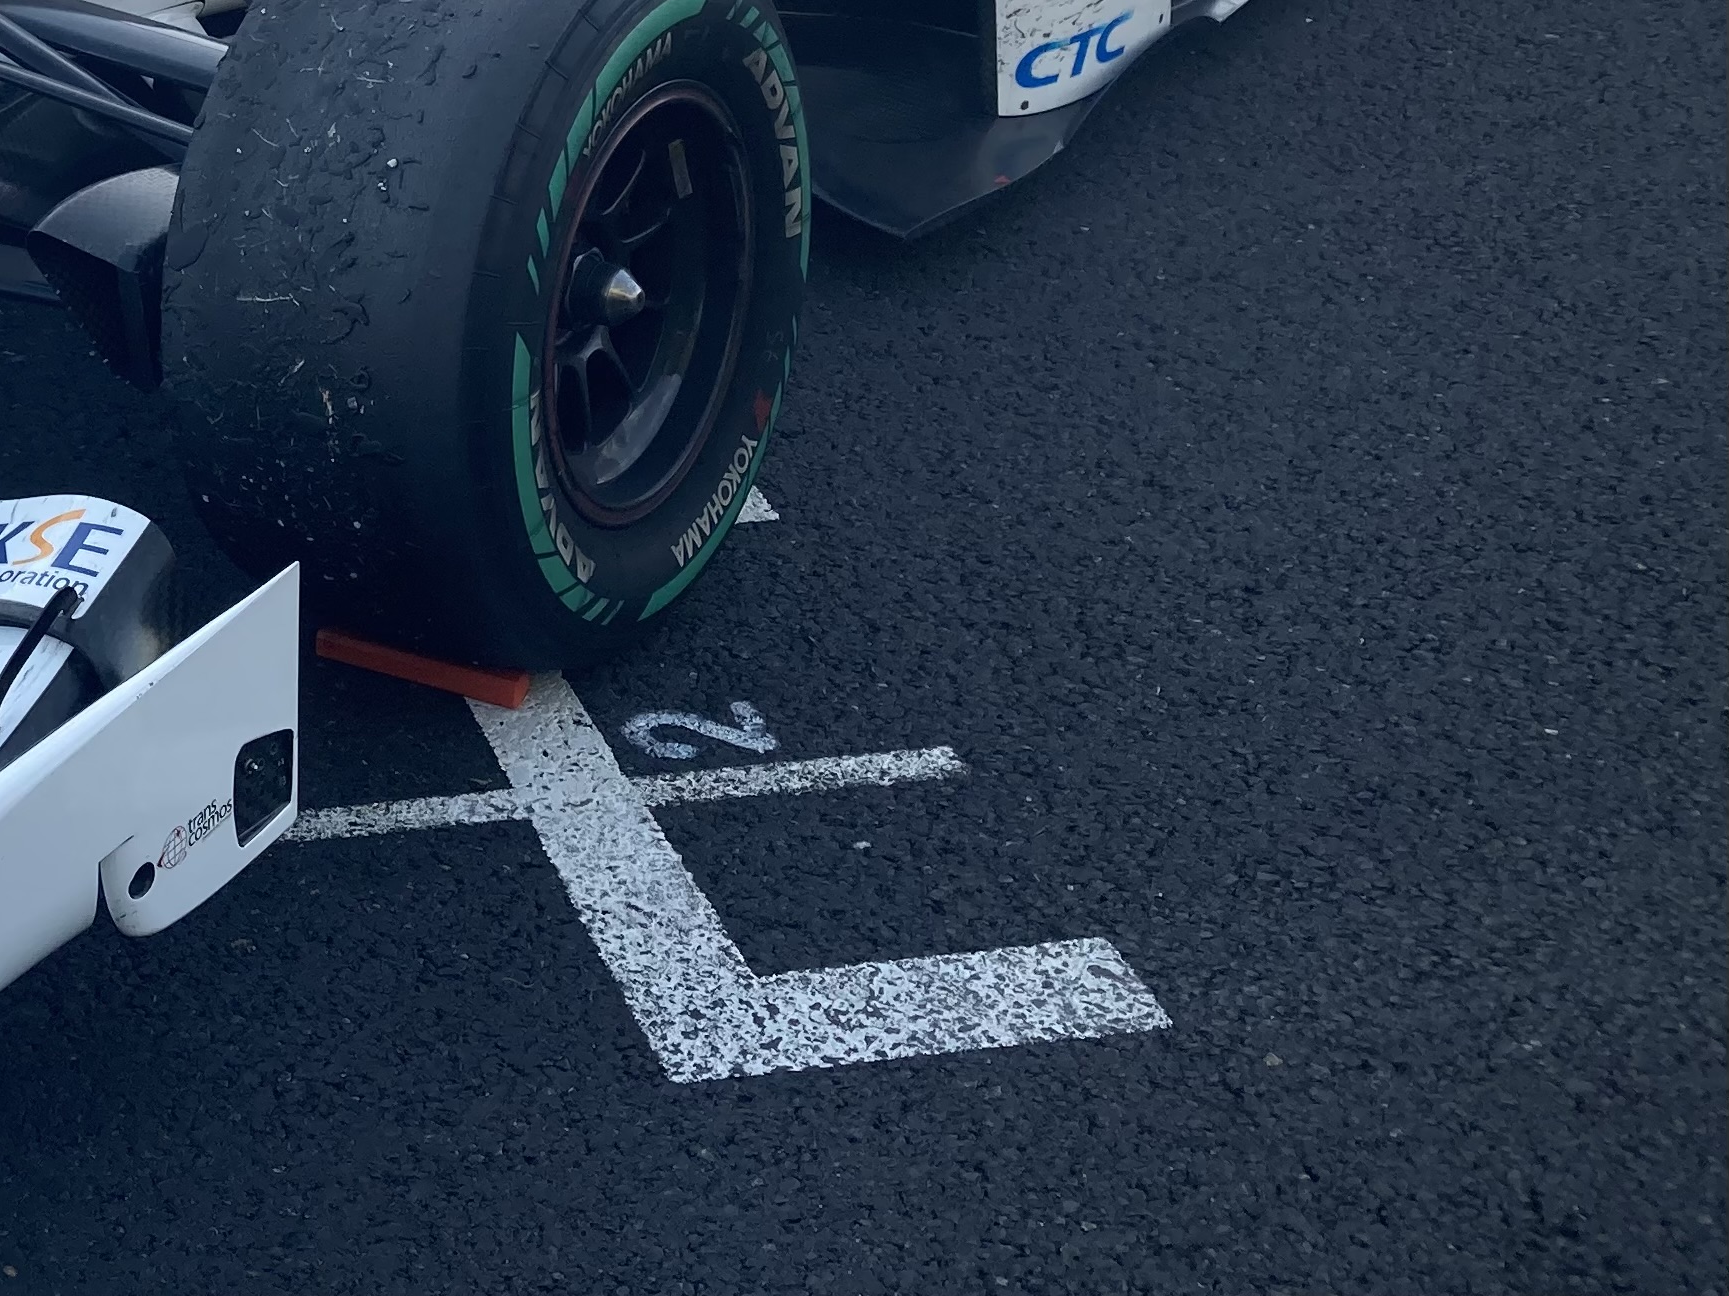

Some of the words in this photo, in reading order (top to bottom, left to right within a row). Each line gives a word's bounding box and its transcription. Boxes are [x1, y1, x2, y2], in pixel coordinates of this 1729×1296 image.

[583, 31, 673, 157] YOKOHAMA
[1015, 9, 1135, 89] CTC
[742, 46, 802, 239] ADVAN
[671, 434, 758, 568] YOKOHAMA
[188, 798, 217, 833] trans
[188, 798, 232, 846] cosmos
